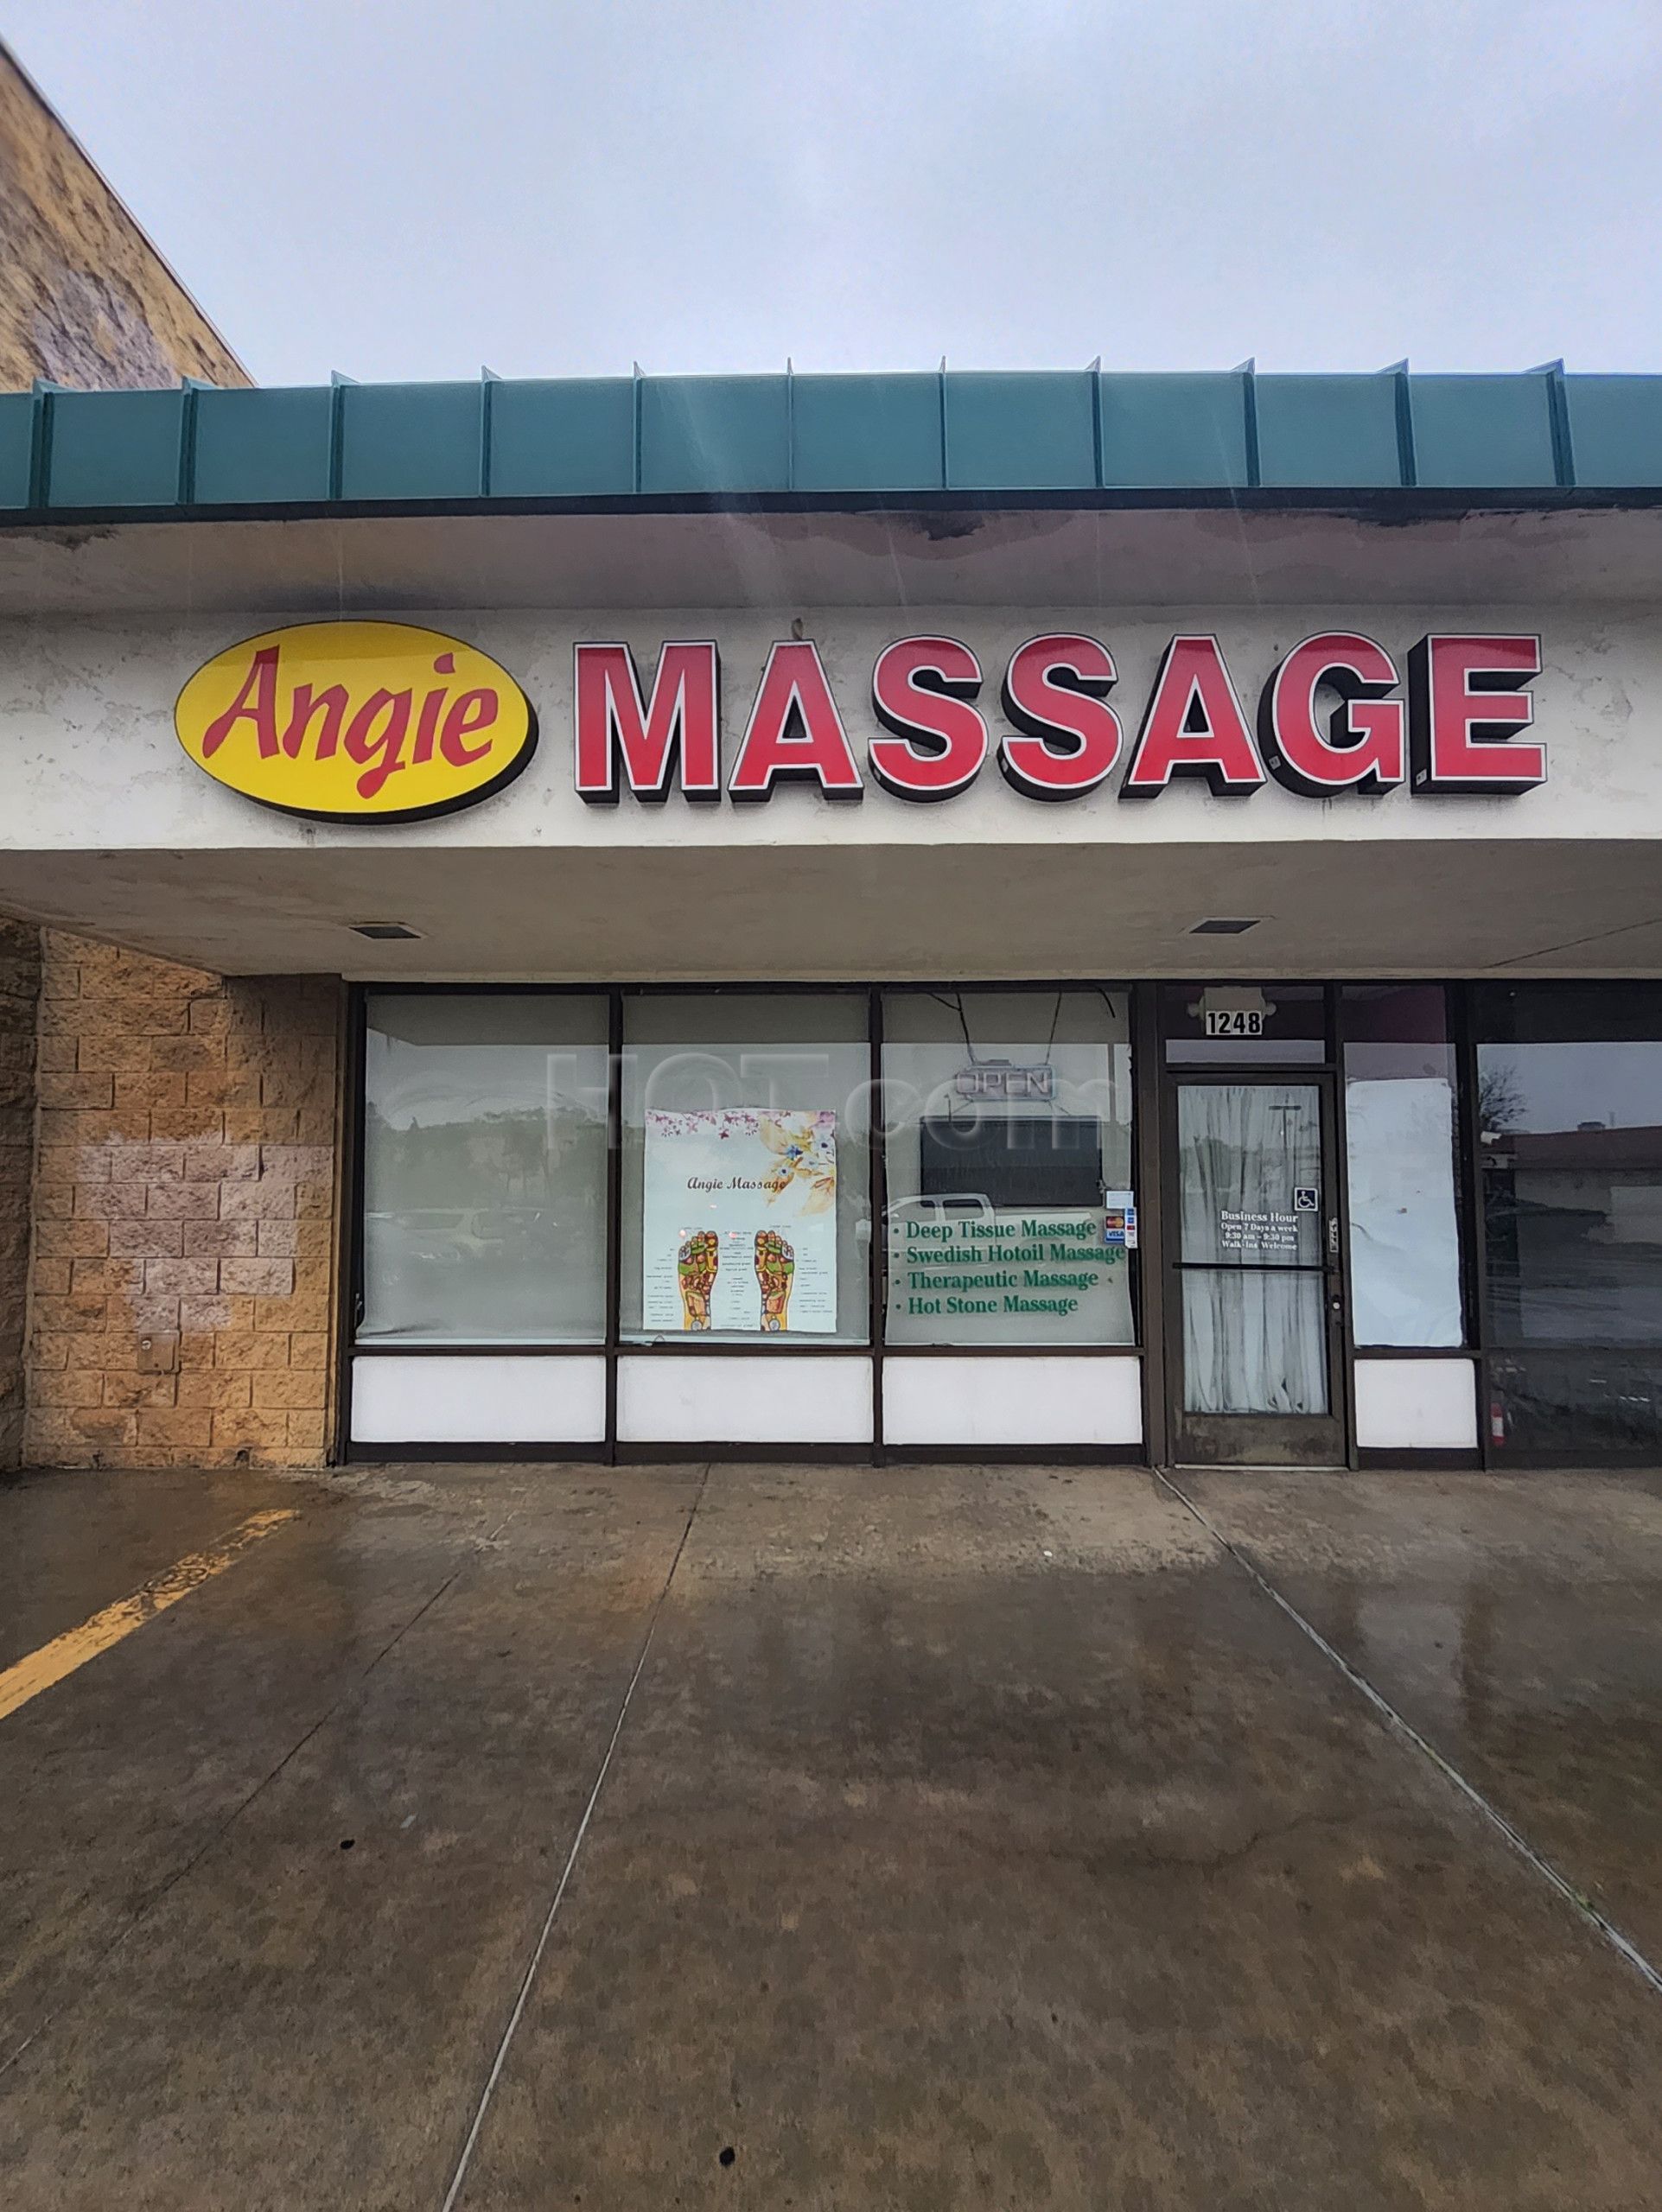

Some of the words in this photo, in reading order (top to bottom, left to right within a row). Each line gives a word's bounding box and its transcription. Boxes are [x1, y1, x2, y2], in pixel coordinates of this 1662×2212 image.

[202, 644, 499, 799] Angie
[574, 632, 1549, 797] MASSAGE
[1208, 1013, 1260, 1033] 1248
[956, 1071, 1049, 1093] OPEN
[687, 1177, 723, 1192] Angie
[727, 1177, 786, 1192] Massage
[1221, 1211, 1267, 1222] Business
[1270, 1212, 1298, 1223] Hour
[907, 1221, 952, 1242] Deep
[958, 1221, 1016, 1237] Tissue
[1021, 1219, 1096, 1240] Massage
[1221, 1222, 1241, 1231] Open
[1250, 1224, 1270, 1233] Days
[907, 1246, 982, 1263] Swedish
[988, 1244, 1044, 1262] Hotoil
[1050, 1243, 1125, 1264] Massage
[1261, 1241, 1297, 1250] Welcome
[908, 1271, 1017, 1293] Therapeutic
[1023, 1270, 1098, 1291] Massage
[908, 1298, 941, 1314] Hot
[946, 1297, 997, 1313] Stone
[1003, 1296, 1078, 1316] Massage
